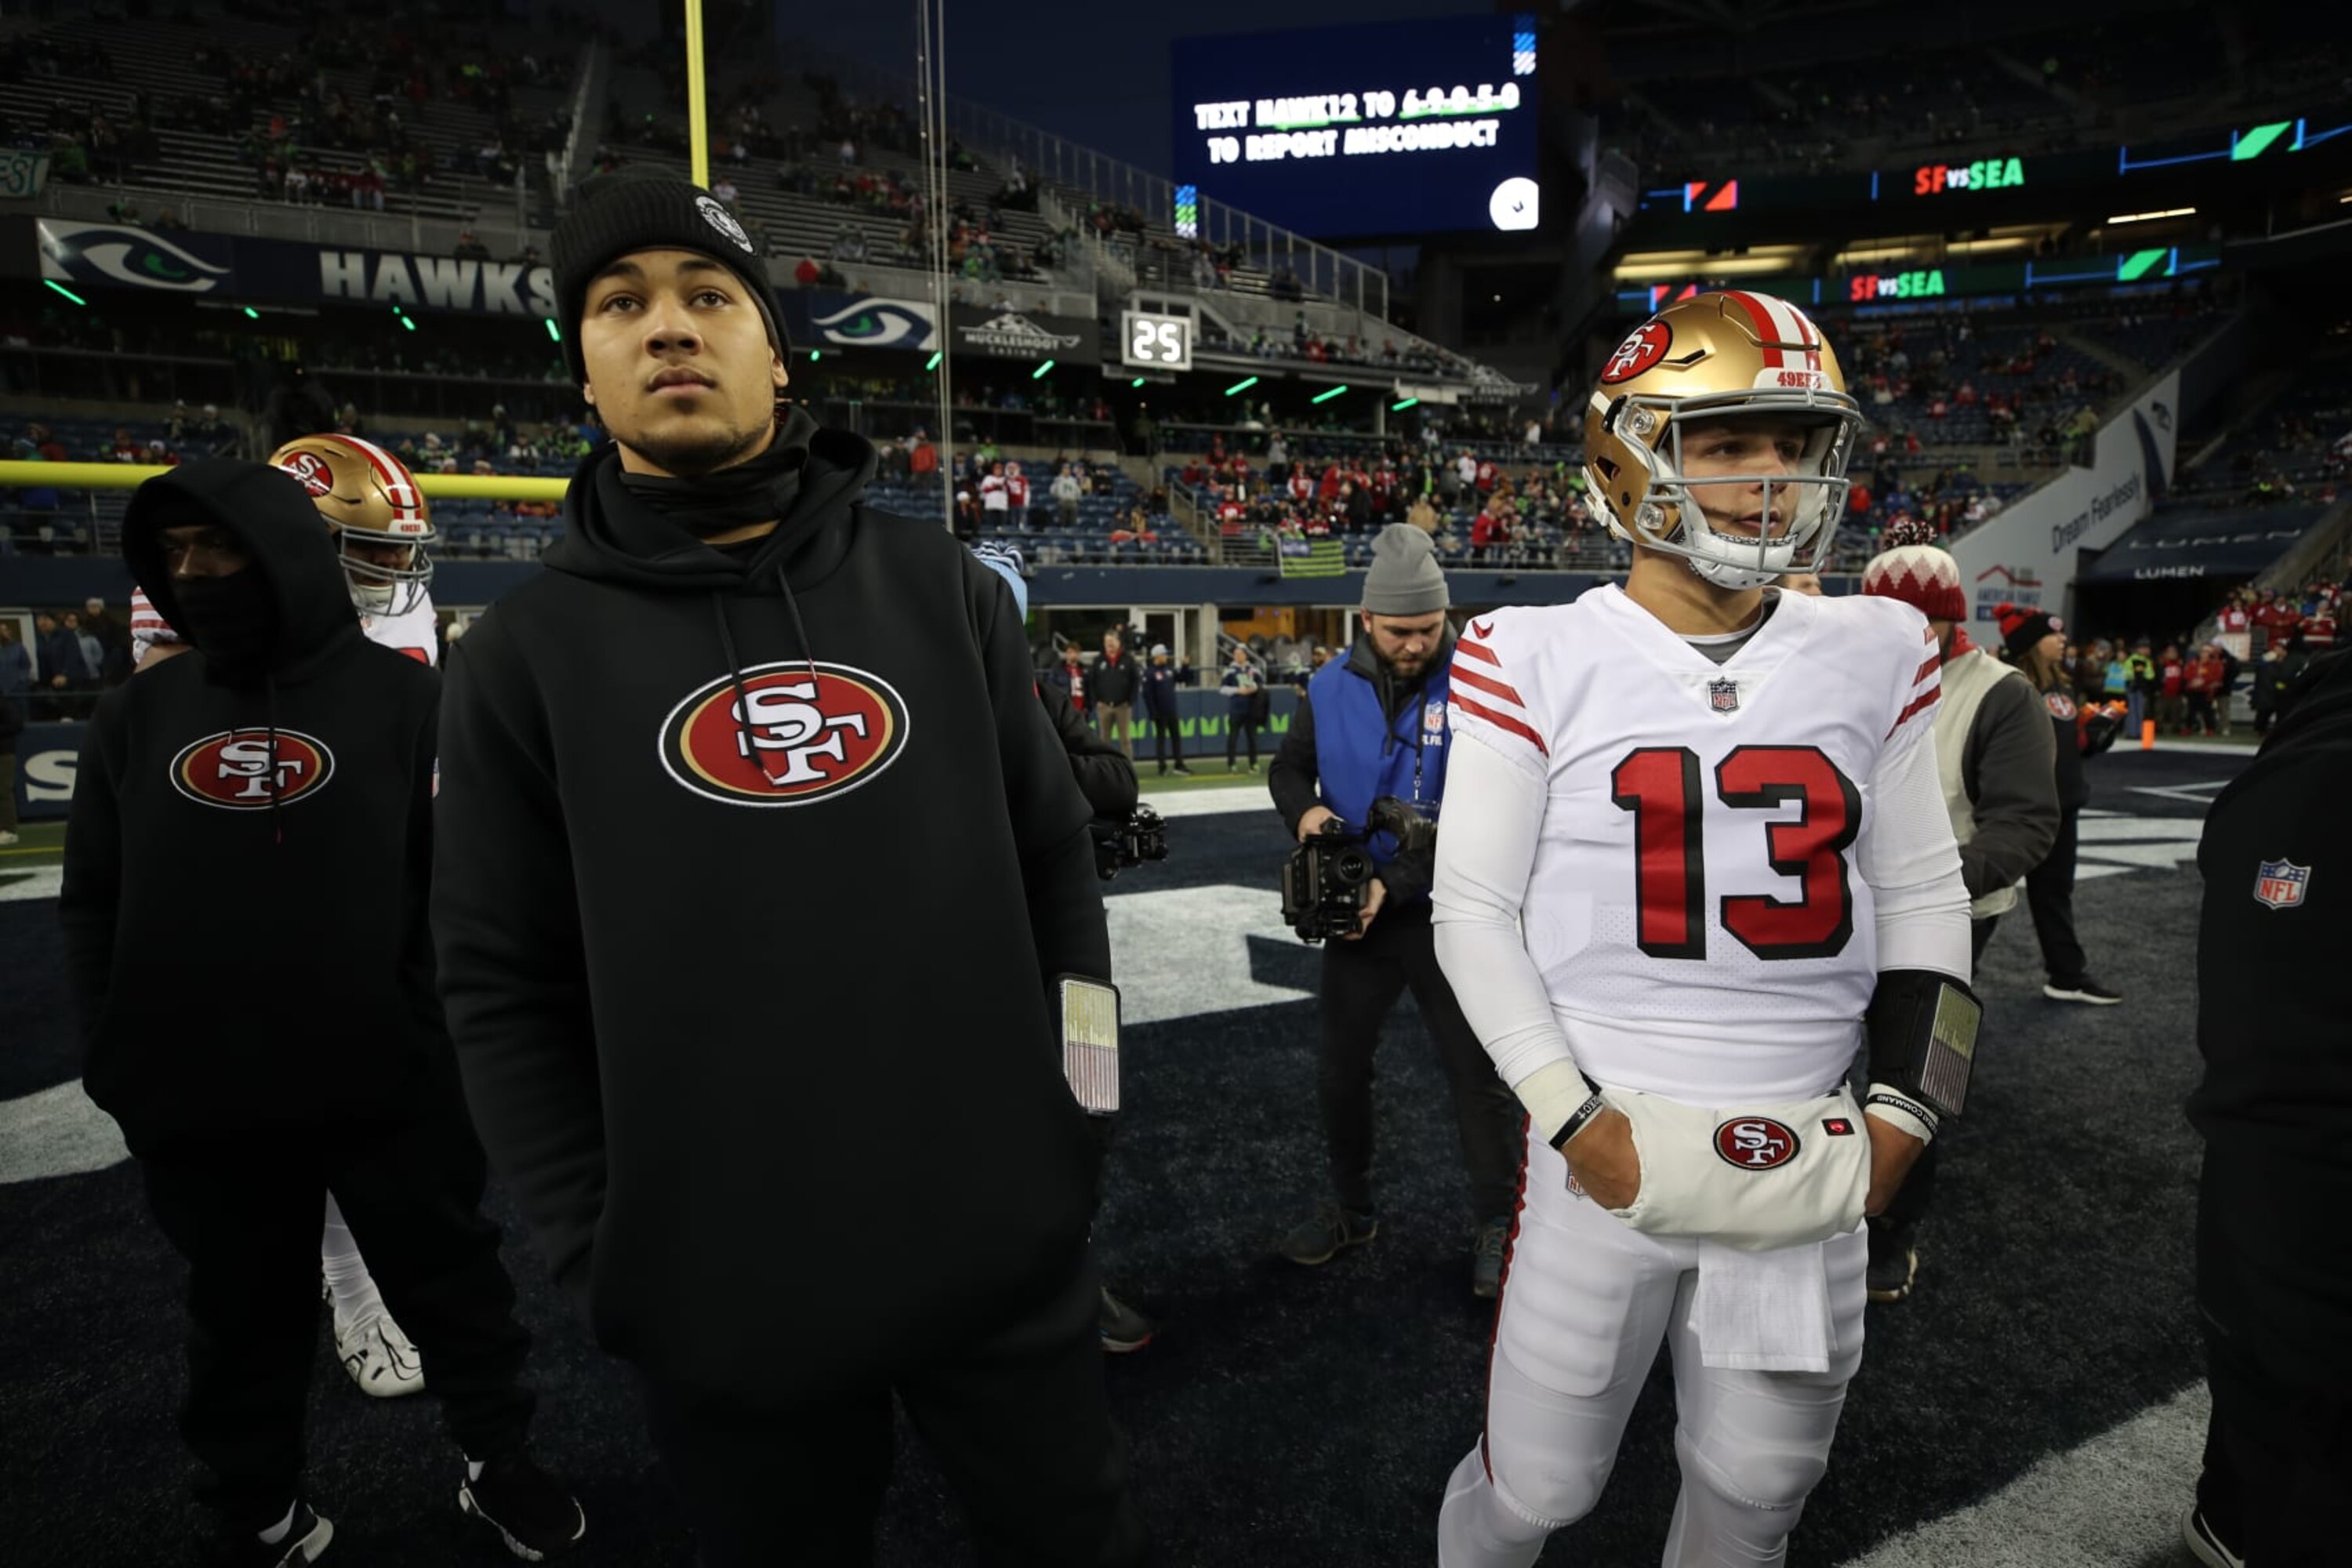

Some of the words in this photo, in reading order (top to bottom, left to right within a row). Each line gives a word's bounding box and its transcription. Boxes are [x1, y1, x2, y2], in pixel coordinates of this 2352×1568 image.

[1195, 101, 1250, 129] TEXT
[1256, 93, 1359, 127] HAWK12
[1363, 91, 1396, 118] TO
[1403, 82, 1520, 117] 6-9-0-5-0
[1208, 136, 1240, 163] TO
[1246, 130, 1338, 162] REPORT
[1344, 119, 1499, 155] MISCONDUCT
[318, 250, 559, 318] HAWKS
[964, 332, 1058, 350] MUCKLESHOOT
[1134, 320, 1181, 362] 25
[2053, 512, 2089, 554] Dream
[2134, 565, 2205, 579] LUMEN
[730, 681, 866, 786] SF
[217, 740, 303, 797] SF
[1611, 745, 1862, 960] 13
[2259, 878, 2298, 902] NFL
[1877, 1094, 1923, 1117] COMMAND
[1733, 1123, 1785, 1164] SF
